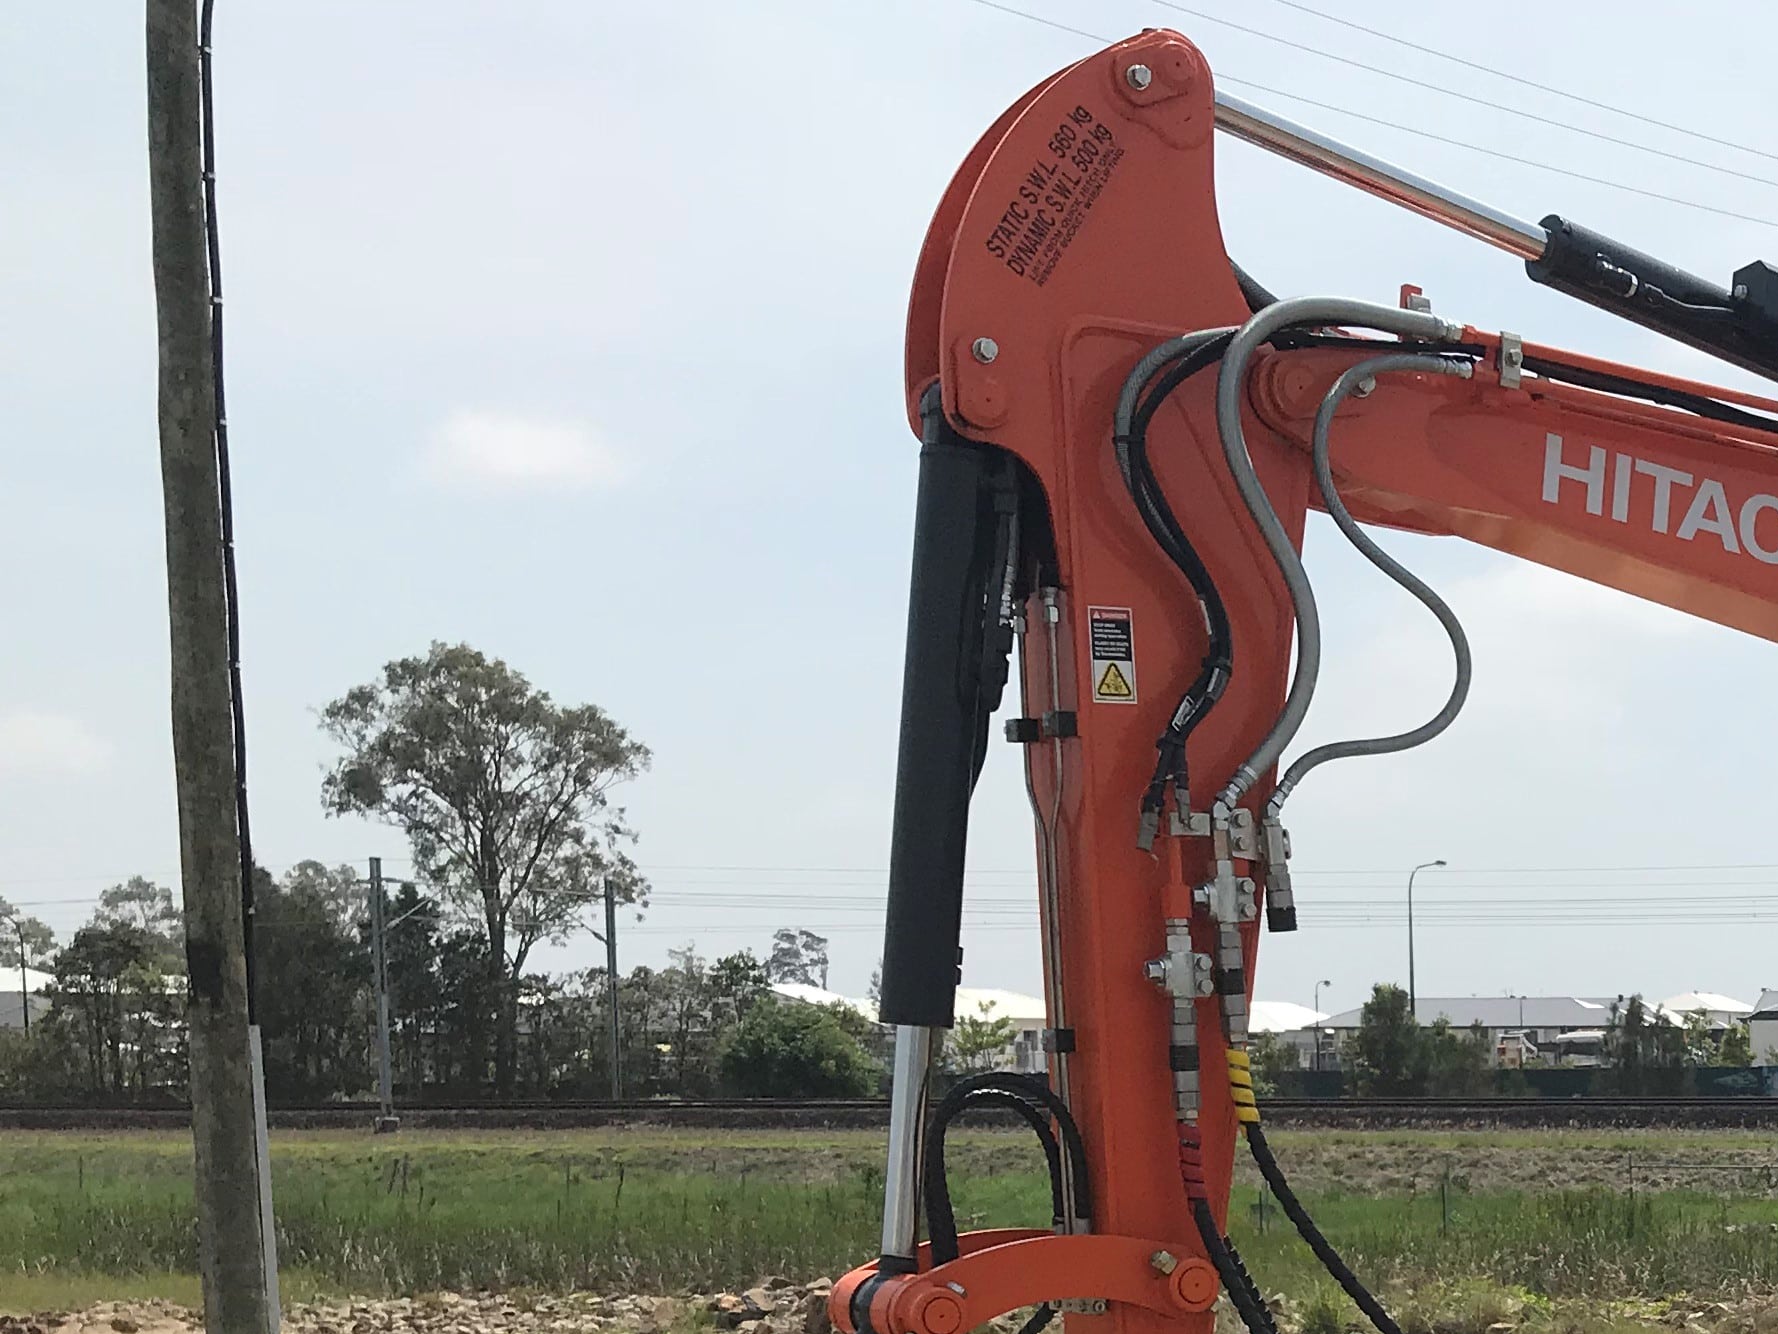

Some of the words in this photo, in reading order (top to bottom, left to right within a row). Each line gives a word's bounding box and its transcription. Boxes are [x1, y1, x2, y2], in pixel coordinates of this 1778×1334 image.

[986, 201, 1029, 258] STATIC
[1048, 124, 1076, 158] 560
[1067, 105, 1092, 128] kg
[1006, 209, 1056, 276] DYNAMIC
[1072, 139, 1099, 173] 500
[1088, 123, 1112, 145] kg
